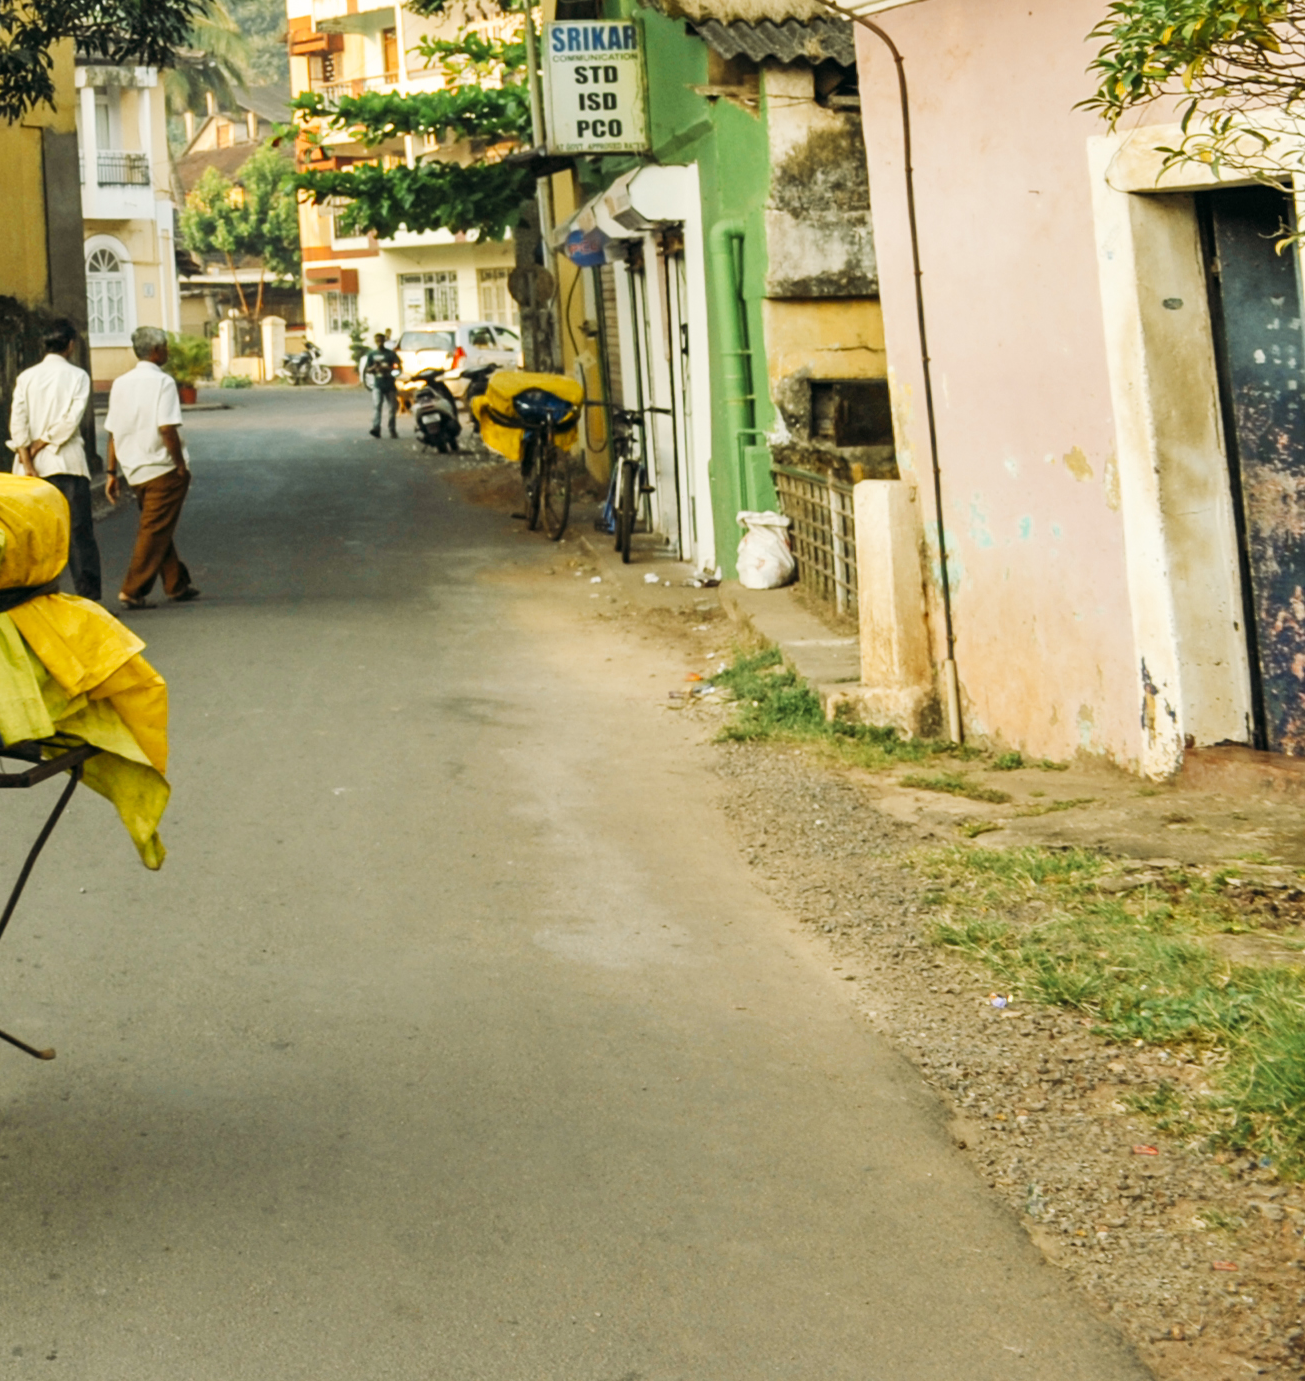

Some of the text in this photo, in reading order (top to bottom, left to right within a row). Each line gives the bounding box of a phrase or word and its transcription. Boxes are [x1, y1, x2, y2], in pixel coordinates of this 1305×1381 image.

[551, 25, 637, 52] SRIKAR
[552, 53, 639, 62] COMMUNICATION
[574, 65, 618, 84] STD
[578, 92, 618, 111] ISD
[577, 119, 622, 138] PCO
